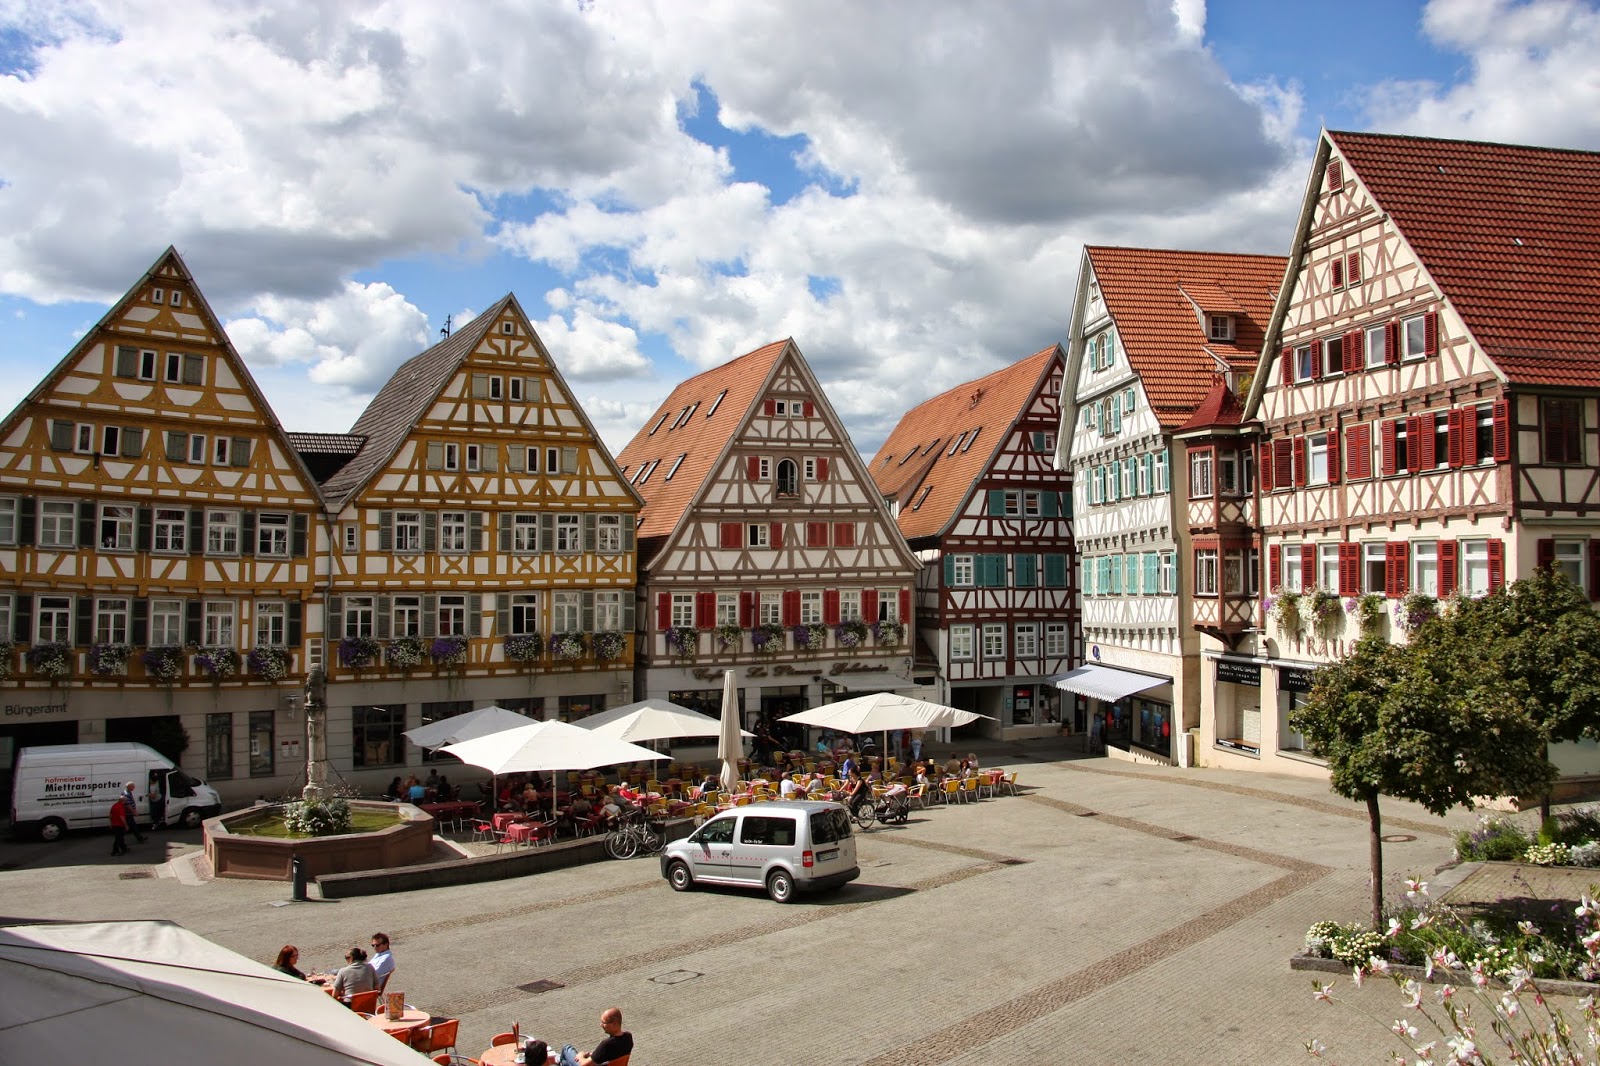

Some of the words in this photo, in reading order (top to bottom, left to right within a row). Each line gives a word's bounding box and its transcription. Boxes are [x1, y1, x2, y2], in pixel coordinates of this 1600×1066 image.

[5, 703, 68, 717] Bürgeramt
[45, 776, 86, 784] hofmeister
[45, 781, 121, 793] Miettransporter
